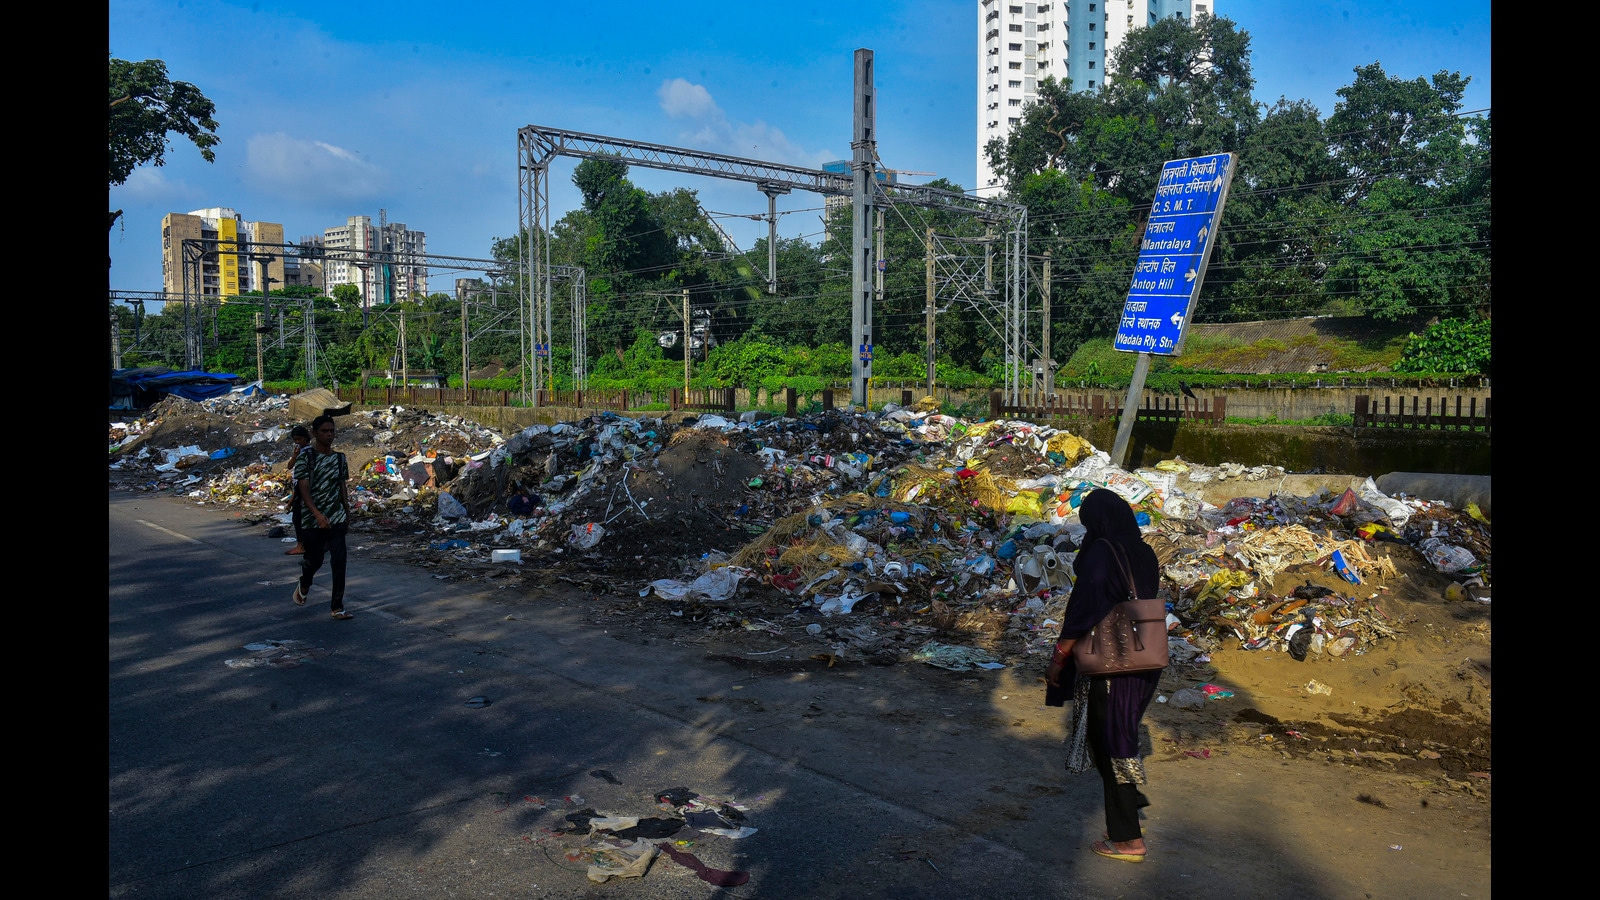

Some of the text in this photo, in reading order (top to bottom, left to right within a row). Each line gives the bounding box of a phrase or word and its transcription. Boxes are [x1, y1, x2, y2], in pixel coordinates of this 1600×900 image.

[1189, 158, 1216, 177] शिवाजी
[1158, 183, 1184, 197] महाराज
[1149, 218, 1175, 233] मंत्रालय
[1142, 238, 1191, 252] Mantralaya
[1161, 257, 1176, 274] हिल
[1132, 279, 1174, 292] Antop Hill
[1126, 301, 1148, 312] वडाळा
[1122, 313, 1162, 330] रेल्वे स्थानक
[1117, 333, 1174, 350] Wadala Rly. Stn.
